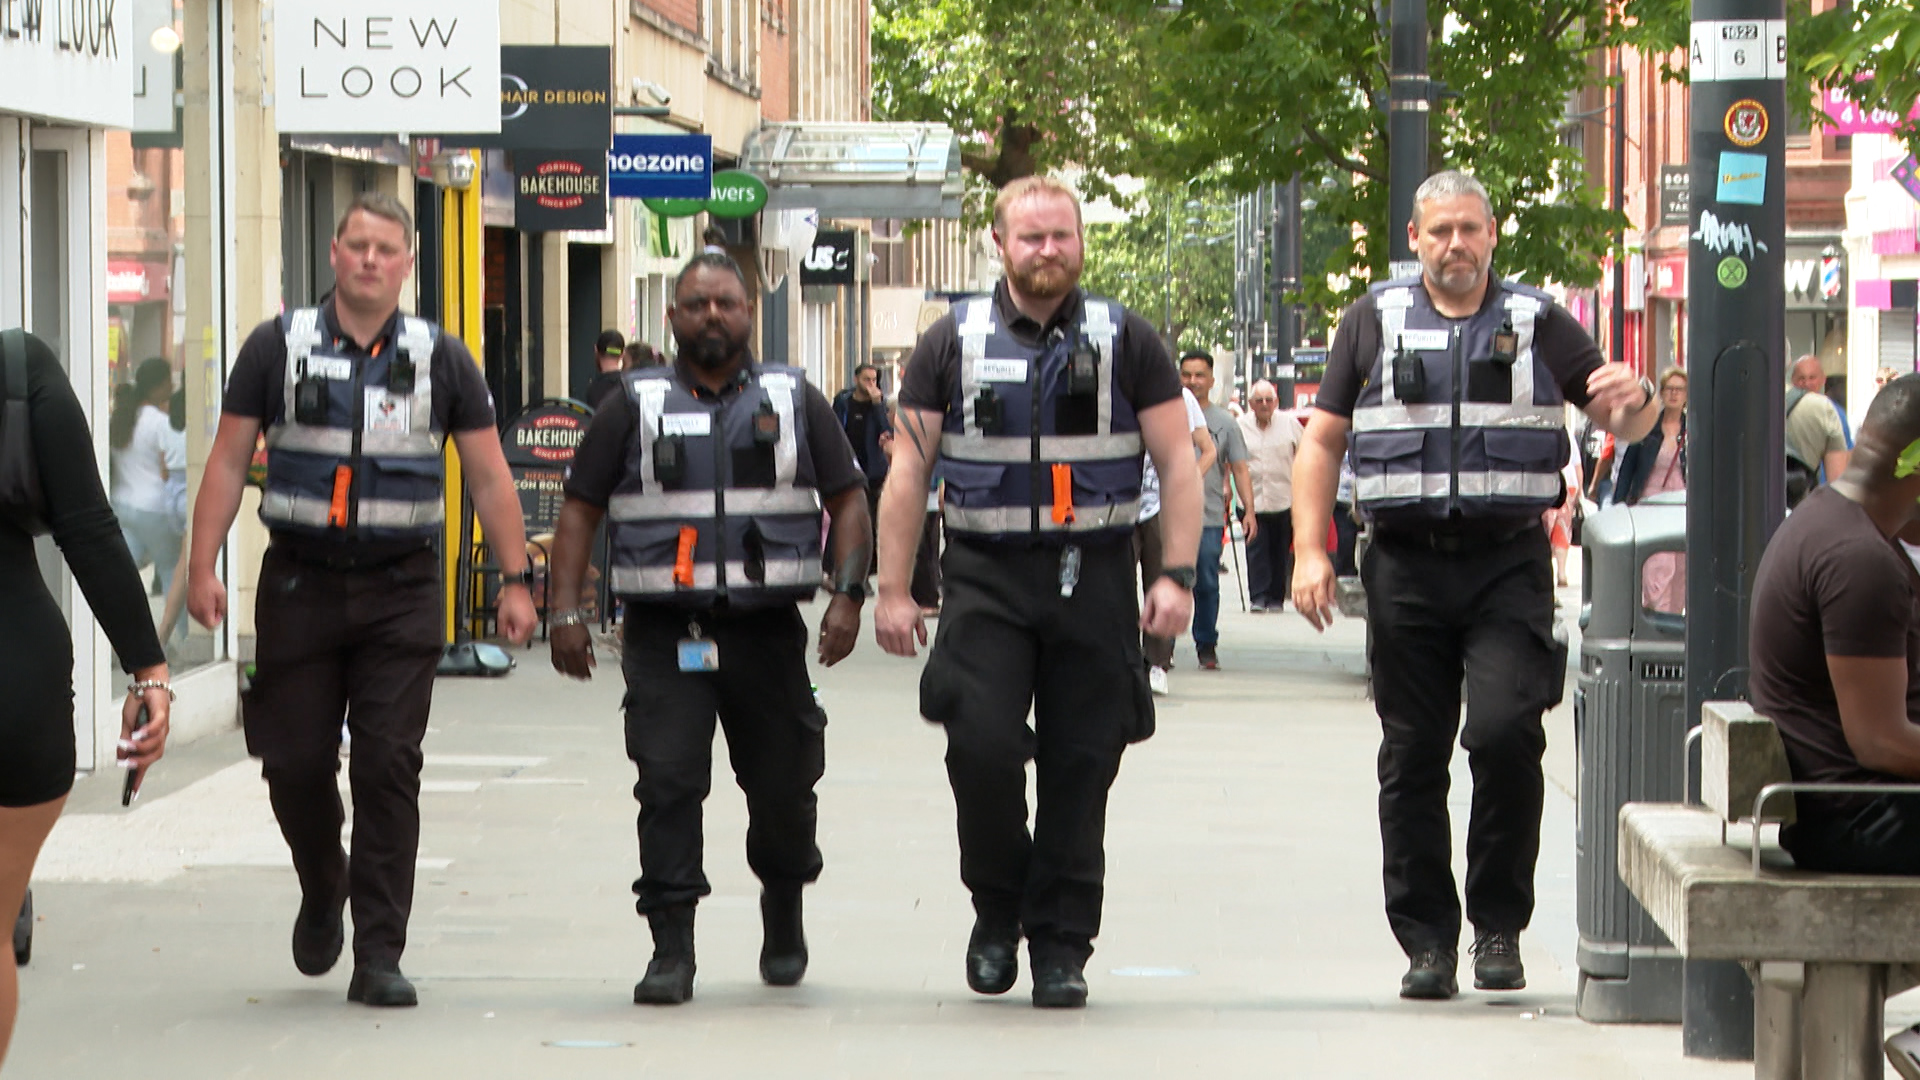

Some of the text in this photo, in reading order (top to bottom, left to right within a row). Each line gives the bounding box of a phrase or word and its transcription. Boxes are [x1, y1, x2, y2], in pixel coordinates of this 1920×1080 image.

[0, 0, 118, 60] EW LOOK
[313, 17, 458, 48] NEW
[1692, 38, 1702, 64] A
[1734, 49, 1745, 66] 6
[1776, 35, 1787, 63] B
[300, 66, 472, 98] LOOK
[501, 90, 606, 104] HAIR DESIGN
[539, 162, 582, 174] CORNISH
[520, 174, 600, 194] BAKEHOUSE
[540, 195, 564, 207] SINCE
[536, 416, 576, 429] CORNISH
[535, 446, 557, 459] SINCE
